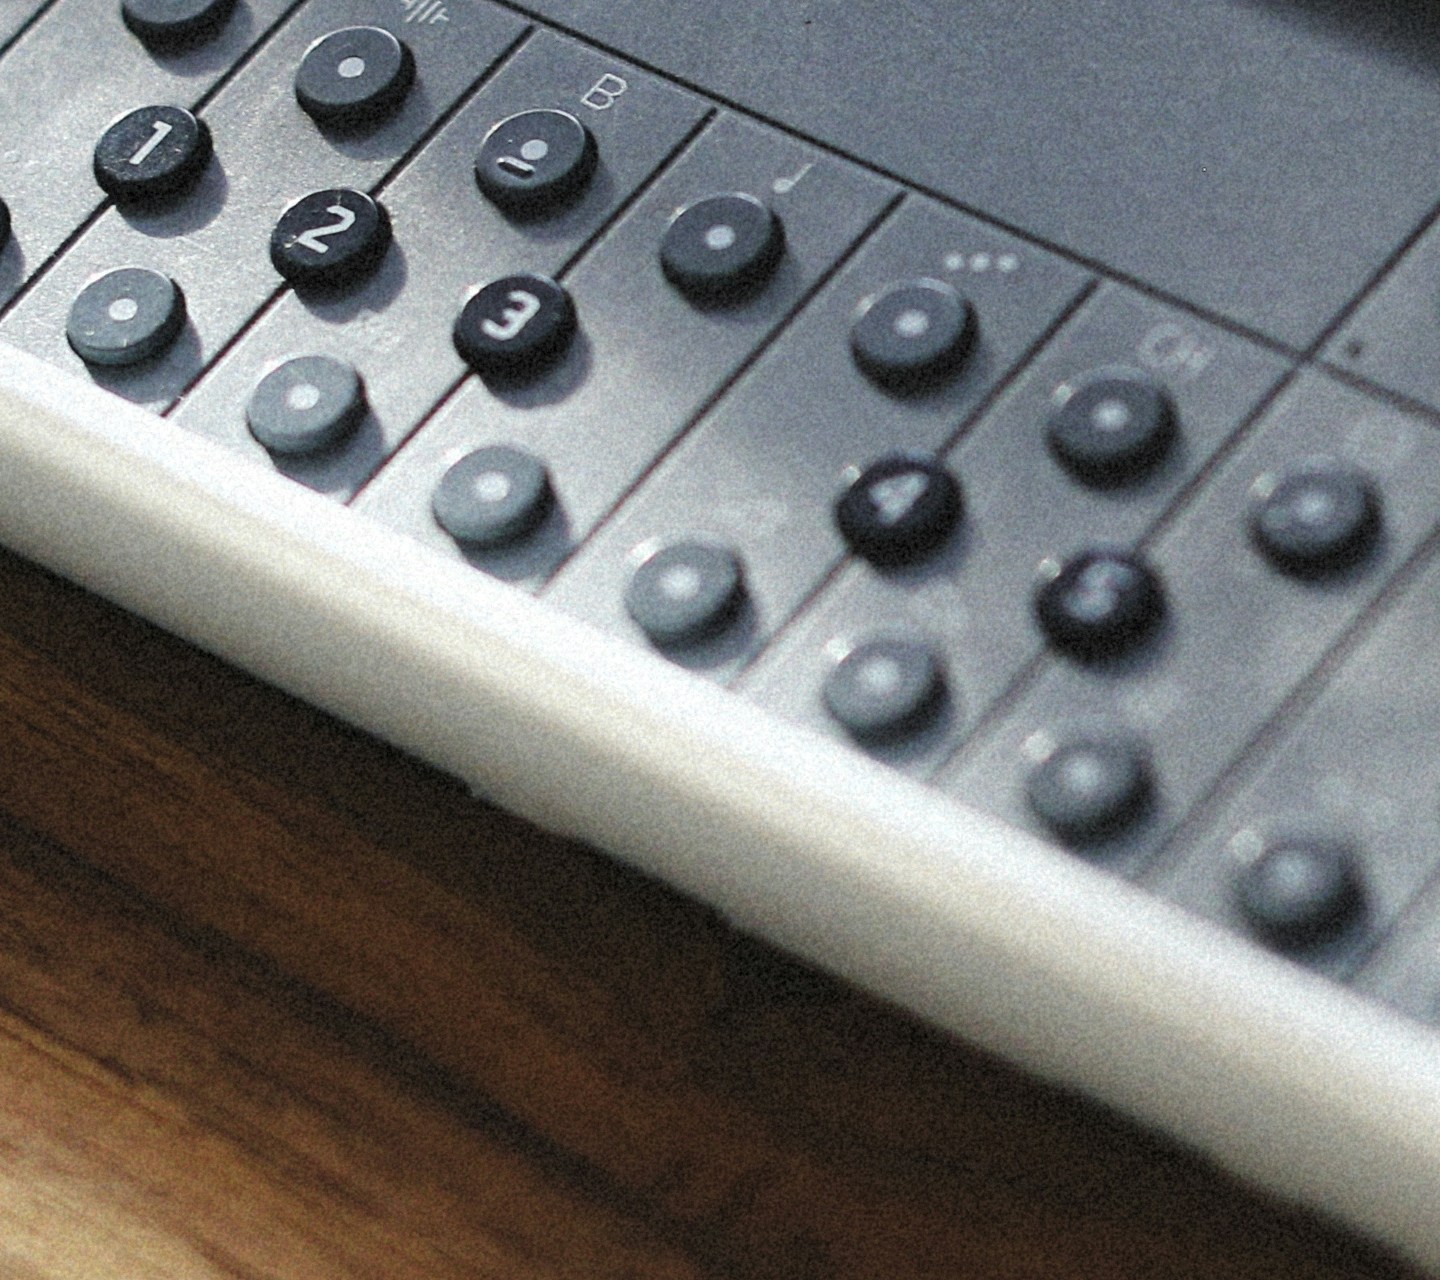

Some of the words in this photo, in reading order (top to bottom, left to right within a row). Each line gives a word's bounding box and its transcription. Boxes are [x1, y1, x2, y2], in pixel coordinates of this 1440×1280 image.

[581, 73, 627, 110] B
[129, 120, 172, 166] 1
[297, 204, 356, 254] 2
[482, 290, 540, 339] 3
